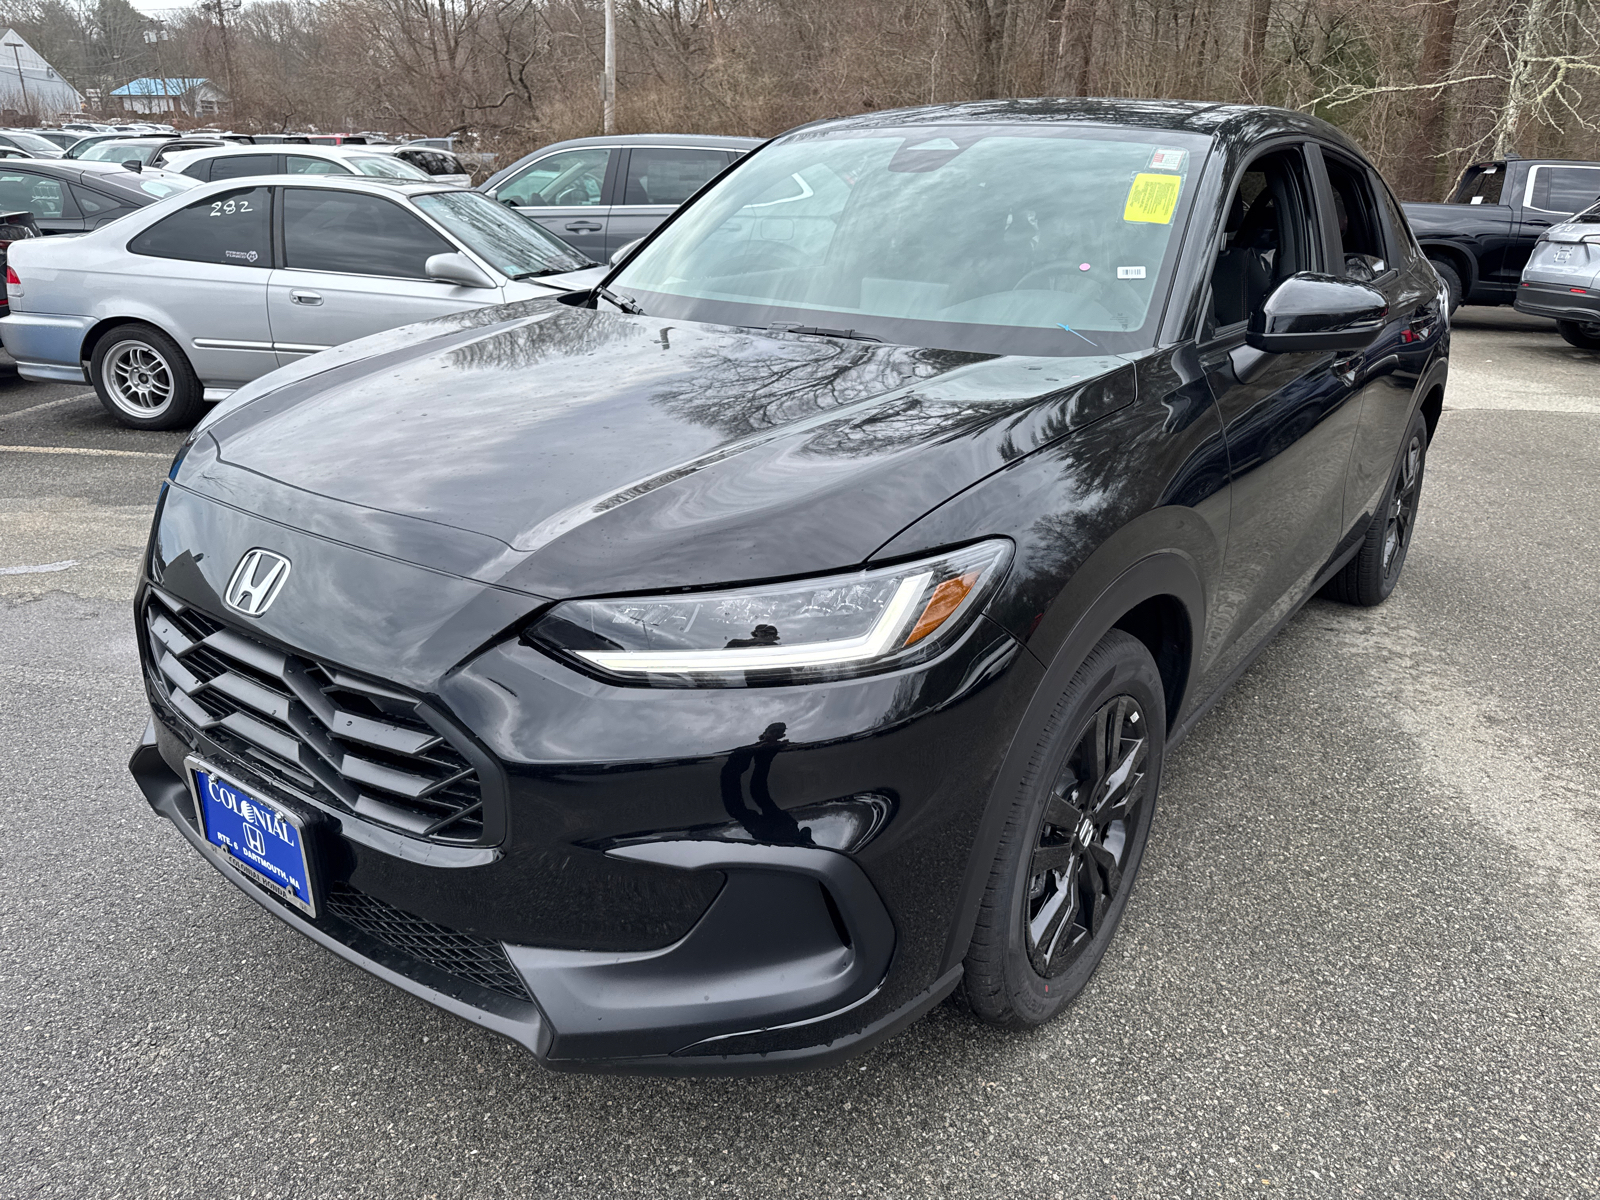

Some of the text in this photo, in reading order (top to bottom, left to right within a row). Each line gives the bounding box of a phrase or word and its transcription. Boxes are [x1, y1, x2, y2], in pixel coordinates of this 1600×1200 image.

[209, 200, 254, 216] 282
[208, 781, 295, 847] COLONIAL
[217, 831, 233, 847] RTE.
[228, 856, 288, 899] COLONIAL HONDA
[242, 847, 289, 883] DARTMOUTH,
[289, 875, 300, 890] MA
